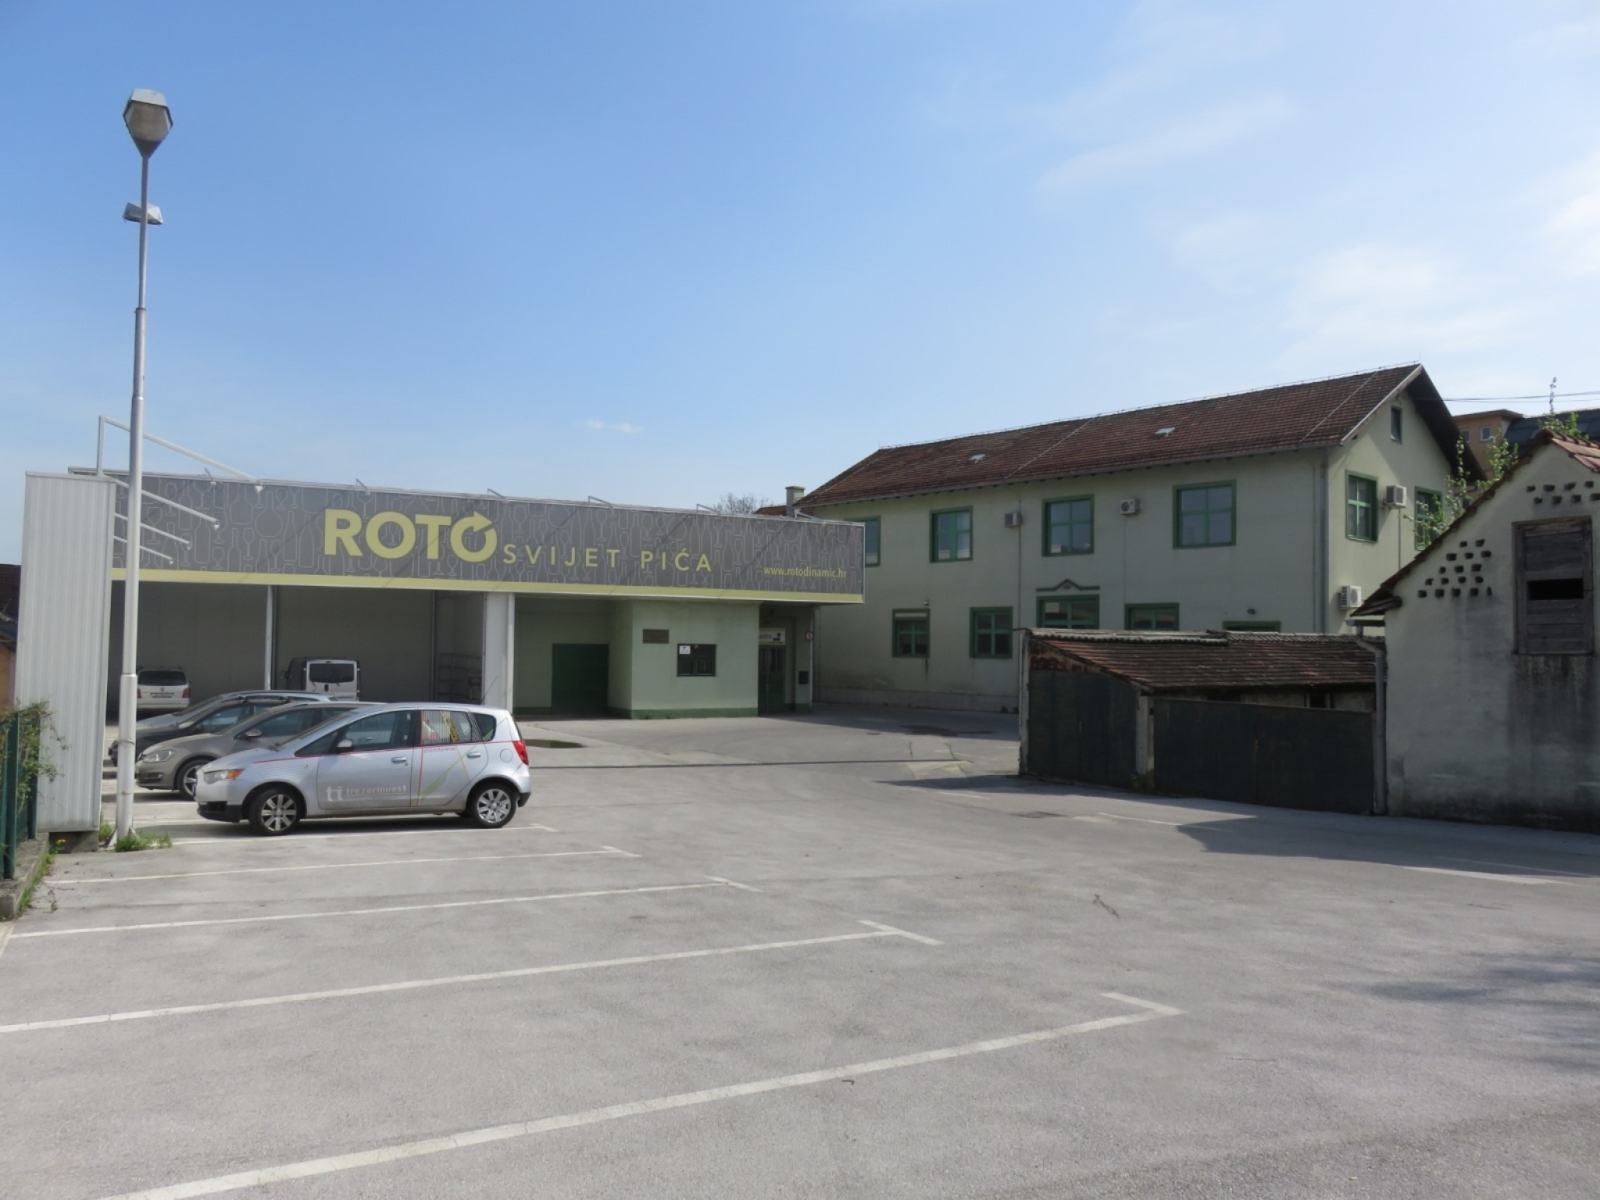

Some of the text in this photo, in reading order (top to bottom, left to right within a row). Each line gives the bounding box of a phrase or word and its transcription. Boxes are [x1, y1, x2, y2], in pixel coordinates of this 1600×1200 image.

[324, 508, 712, 572] ROTO SVIJET PIĆA
